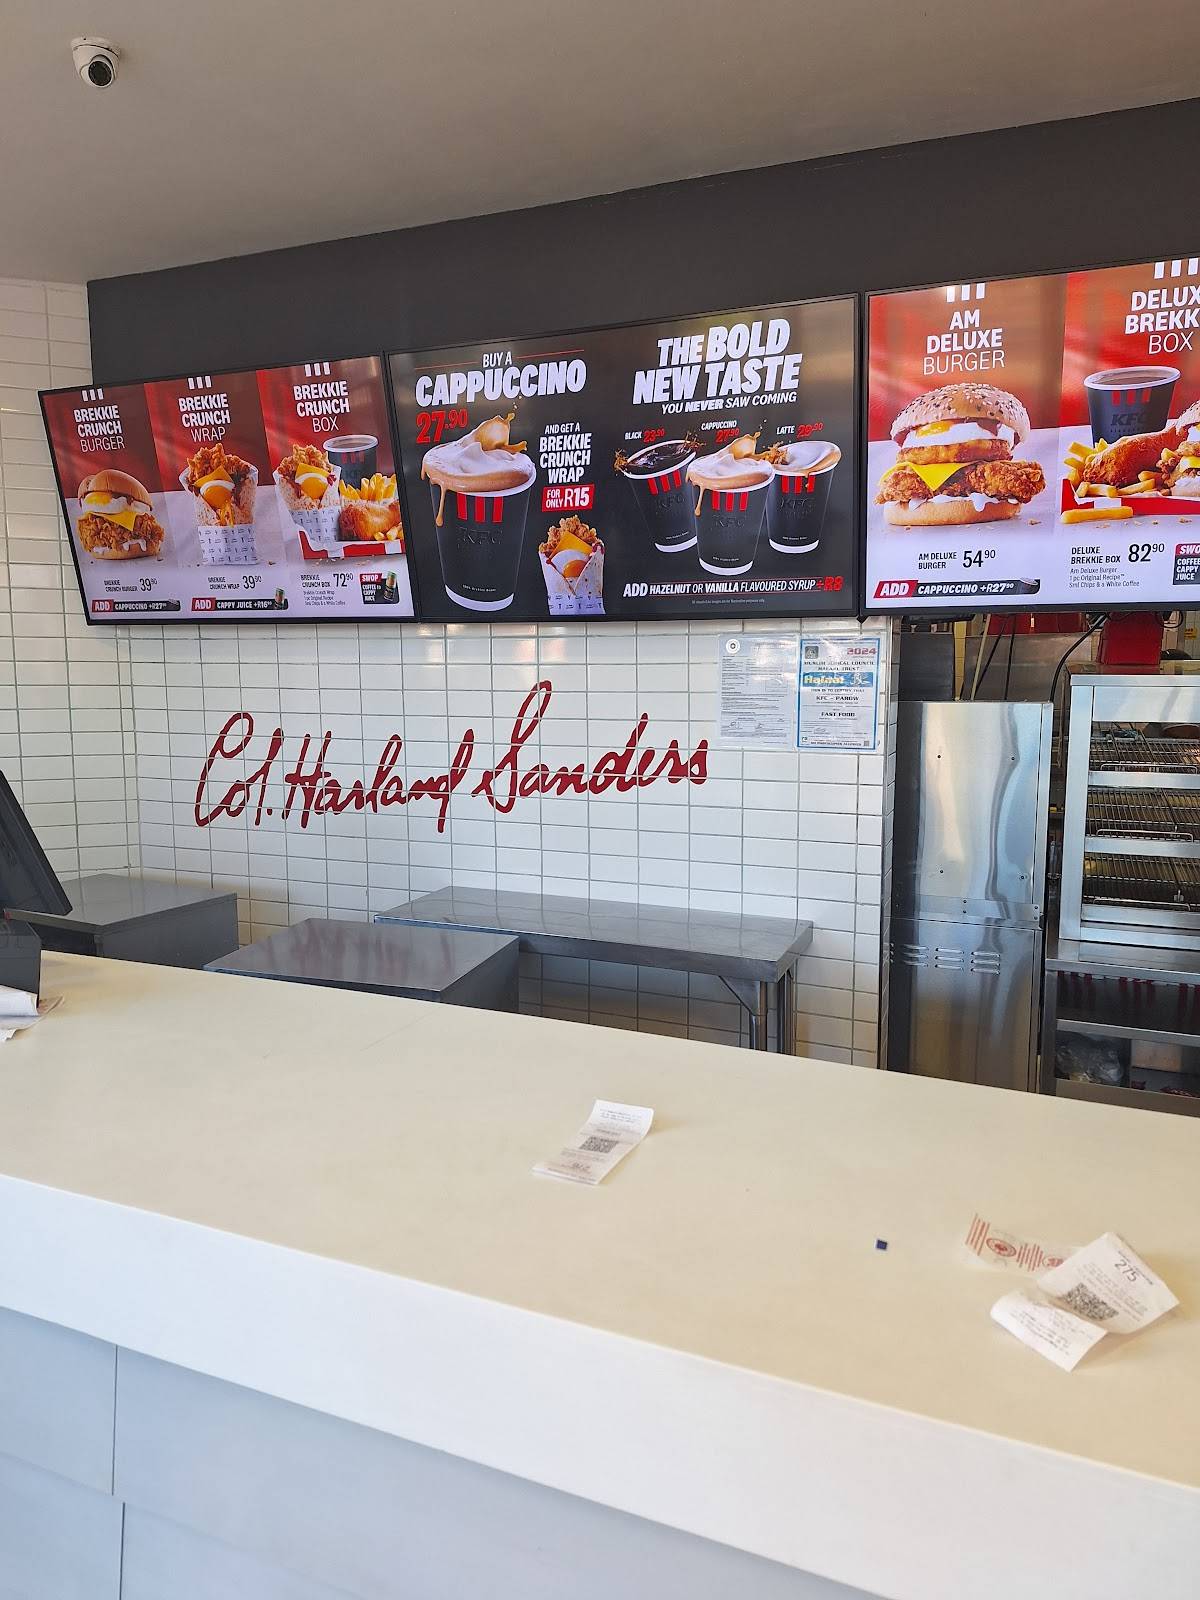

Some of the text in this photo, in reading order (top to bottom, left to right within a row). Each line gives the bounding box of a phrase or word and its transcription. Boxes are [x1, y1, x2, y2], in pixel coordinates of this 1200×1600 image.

[949, 309, 980, 330] AM
[657, 318, 791, 367] THE BOLD
[927, 328, 1002, 354] DELUXE
[1148, 331, 1193, 354] BOX
[483, 351, 512, 368] BUY A
[923, 349, 1005, 375] BURGER
[415, 359, 587, 407] CAPPUCCINO
[632, 353, 803, 404] NEW TASTE
[293, 381, 348, 400] BREKKIE
[179, 393, 228, 412] BREKKIE
[297, 398, 350, 417] CRUNCH
[662, 392, 797, 415] YOU NEVER SAW COMING
[74, 405, 120, 422] BREKKIE
[182, 410, 231, 427] CRUNCH
[77, 421, 122, 437] CRUNCH
[313, 416, 339, 432] BOX
[416, 409, 468, 444] 27.90
[544, 422, 580, 434] AND GET A
[701, 420, 738, 430] CAPPUCCINO
[776, 425, 795, 435] LATTE
[191, 427, 226, 442] WRAP
[539, 433, 592, 452] BREKKIE
[624, 431, 642, 440] BLACK
[80, 436, 125, 452] BURGER
[540, 450, 591, 468] CRUNCH
[548, 467, 584, 484] WRAP
[546, 498, 563, 508] ONLY
[547, 487, 590, 507] FOR R15
[930, 552, 957, 560] DELUXE
[1071, 546, 1100, 555] DELUXE
[918, 562, 946, 570] BURGER
[1070, 555, 1121, 564] BREKKIE BOX
[623, 582, 648, 597] ADD
[650, 583, 691, 594] HAZELNUT
[692, 584, 703, 593] OR
[705, 582, 739, 593] VANILLA
[740, 580, 787, 592] FLAVOURED
[787, 579, 816, 590] SYRUP
[880, 582, 909, 596] ADD
[918, 584, 978, 595] CAPPUCCINO
[95, 601, 111, 611] ADD
[195, 600, 212, 610] ADD
[470, 680, 708, 813] Sanders
